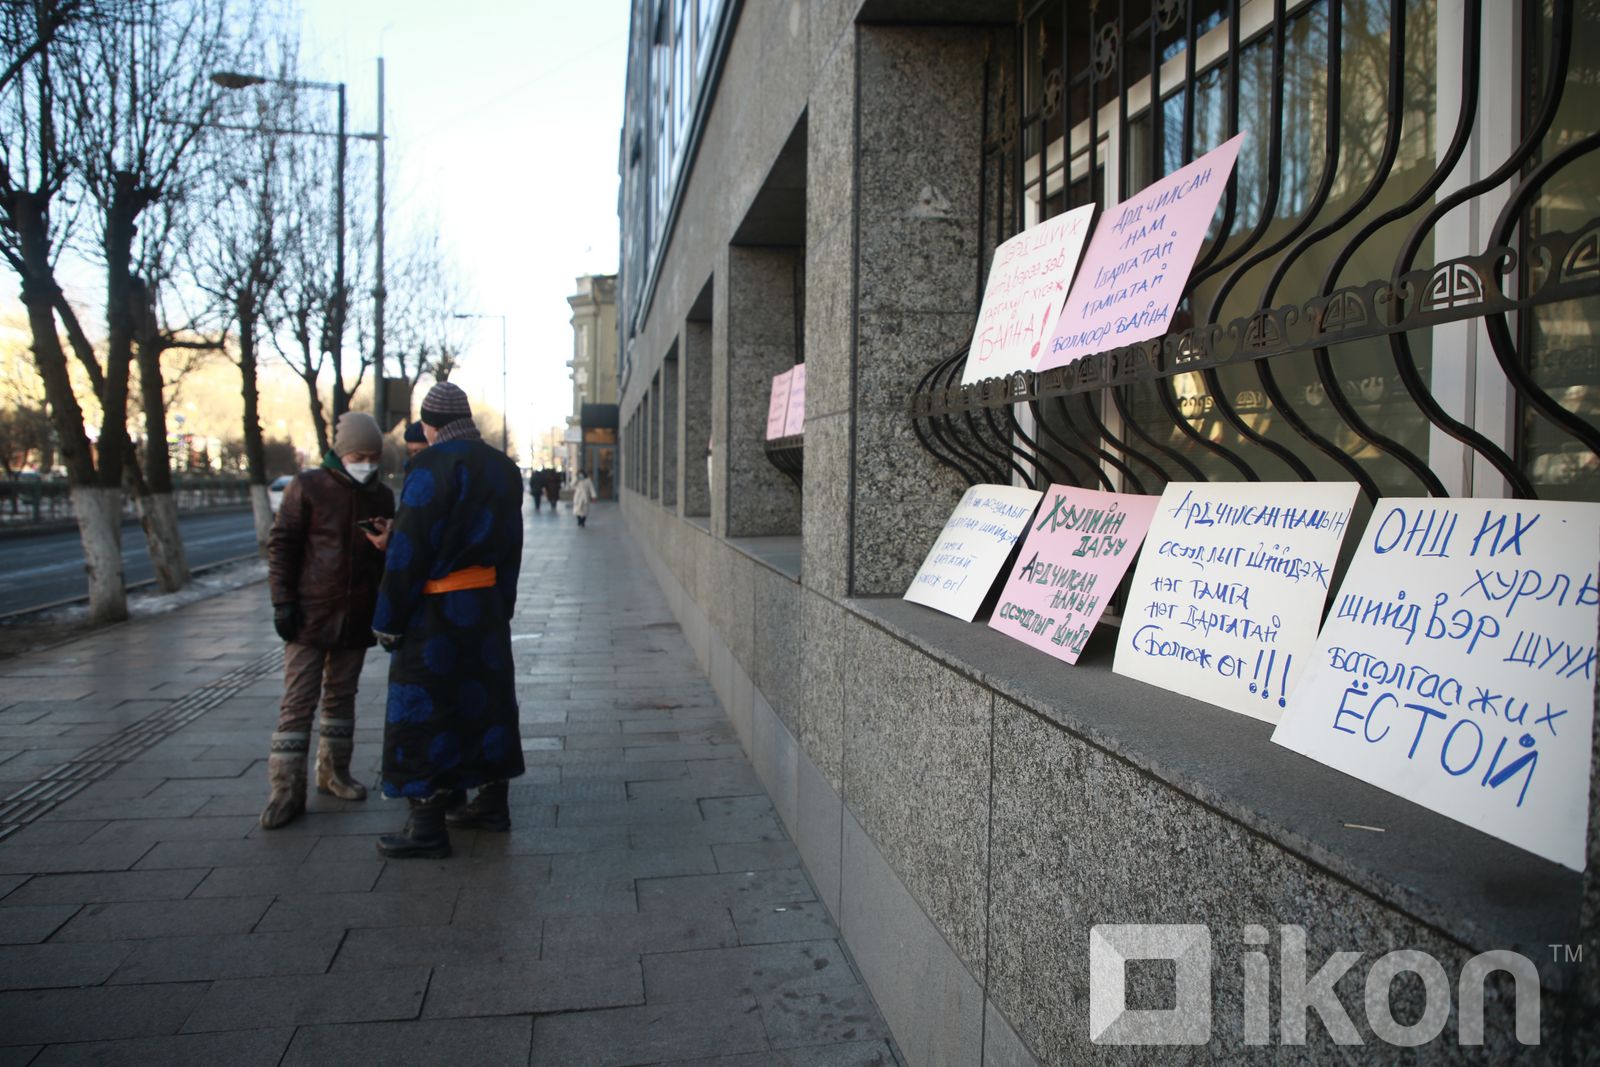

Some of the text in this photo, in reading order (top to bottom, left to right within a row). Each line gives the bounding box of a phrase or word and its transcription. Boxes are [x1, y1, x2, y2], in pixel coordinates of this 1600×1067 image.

[1120, 214, 1166, 250] НАМ
[1072, 535, 1128, 558] ДАГУУ
[1469, 509, 1541, 557] ИХ
[1332, 678, 1539, 808] ЁСТОЙ
